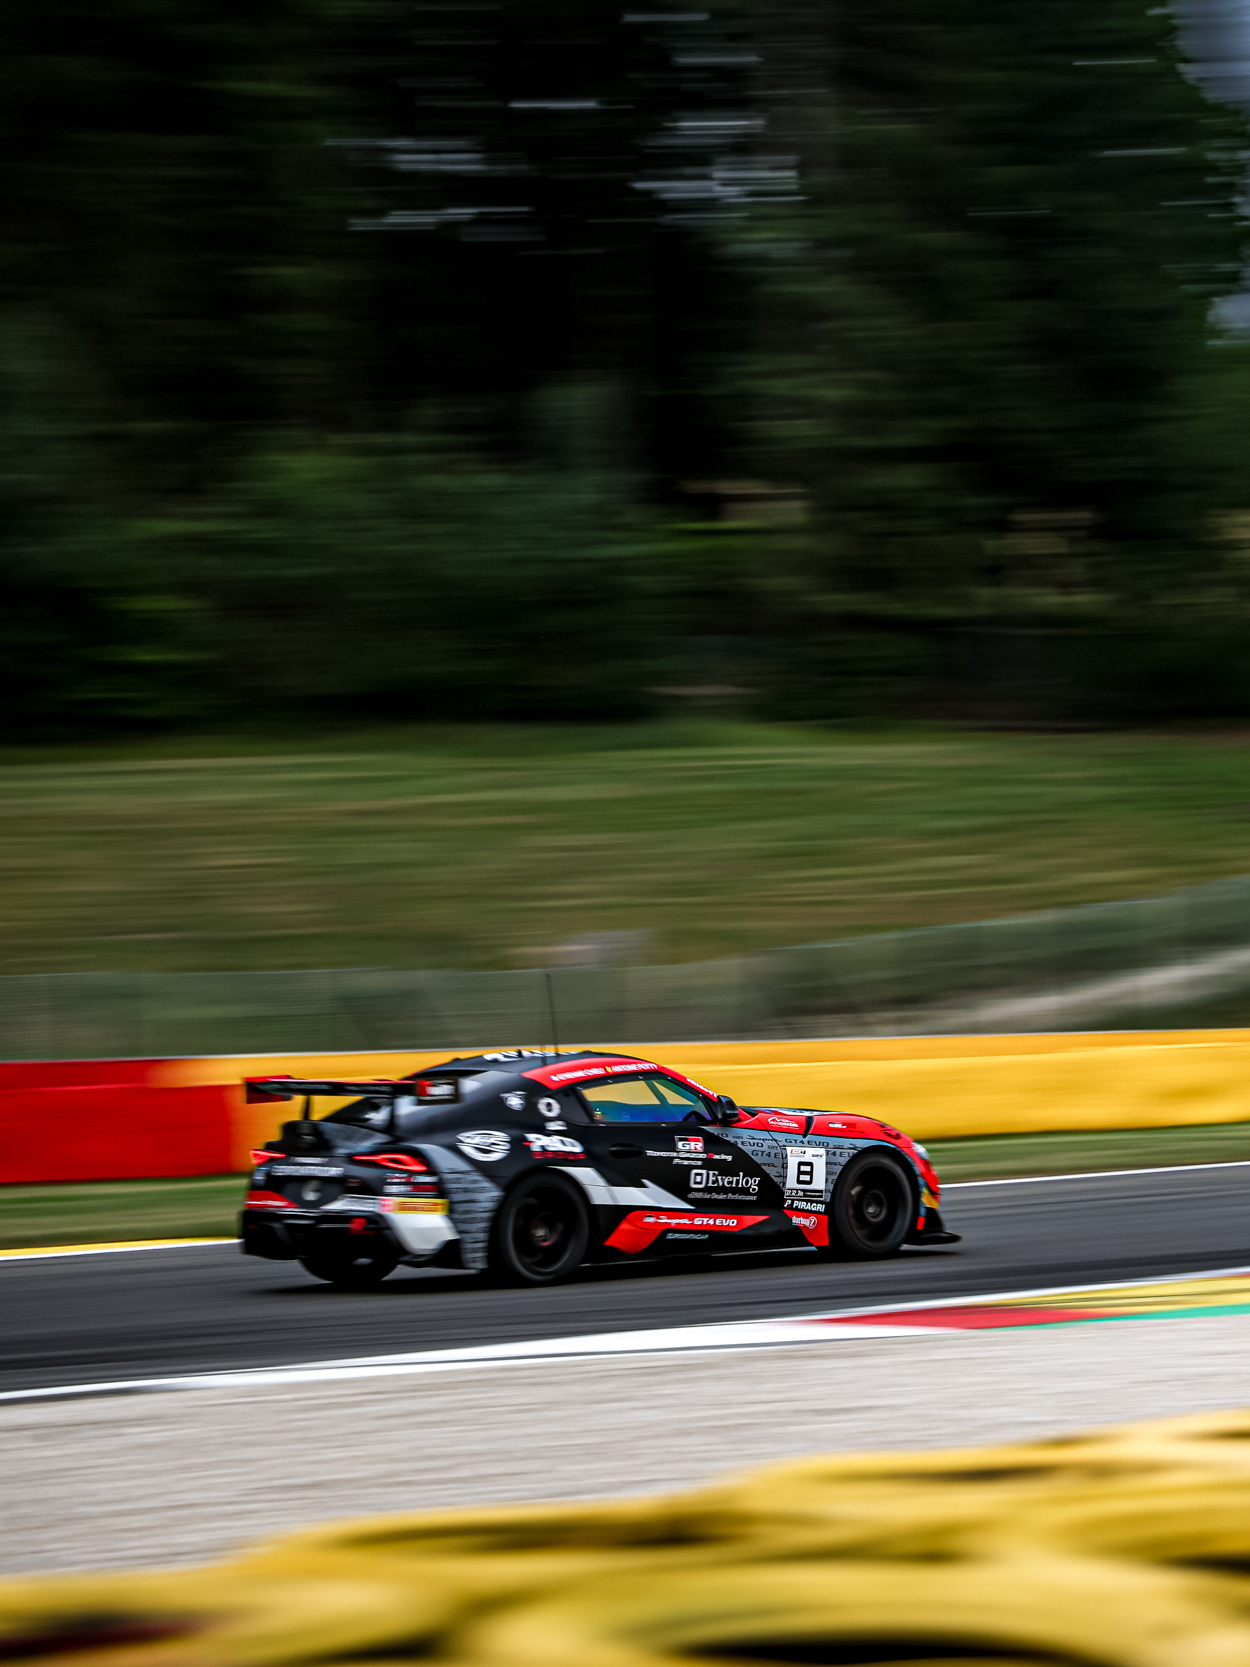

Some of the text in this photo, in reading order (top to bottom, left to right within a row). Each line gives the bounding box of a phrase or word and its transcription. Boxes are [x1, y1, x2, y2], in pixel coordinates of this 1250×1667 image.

[678, 1141, 703, 1151] GR
[741, 1140, 764, 1148] EVO
[751, 1149, 771, 1158] GT4
[796, 1161, 814, 1185] 8
[707, 1170, 761, 1194] Everlog
[793, 1200, 826, 1213] PIRAGRI
[693, 1217, 715, 1225] GT4
[715, 1218, 738, 1227] EVO
